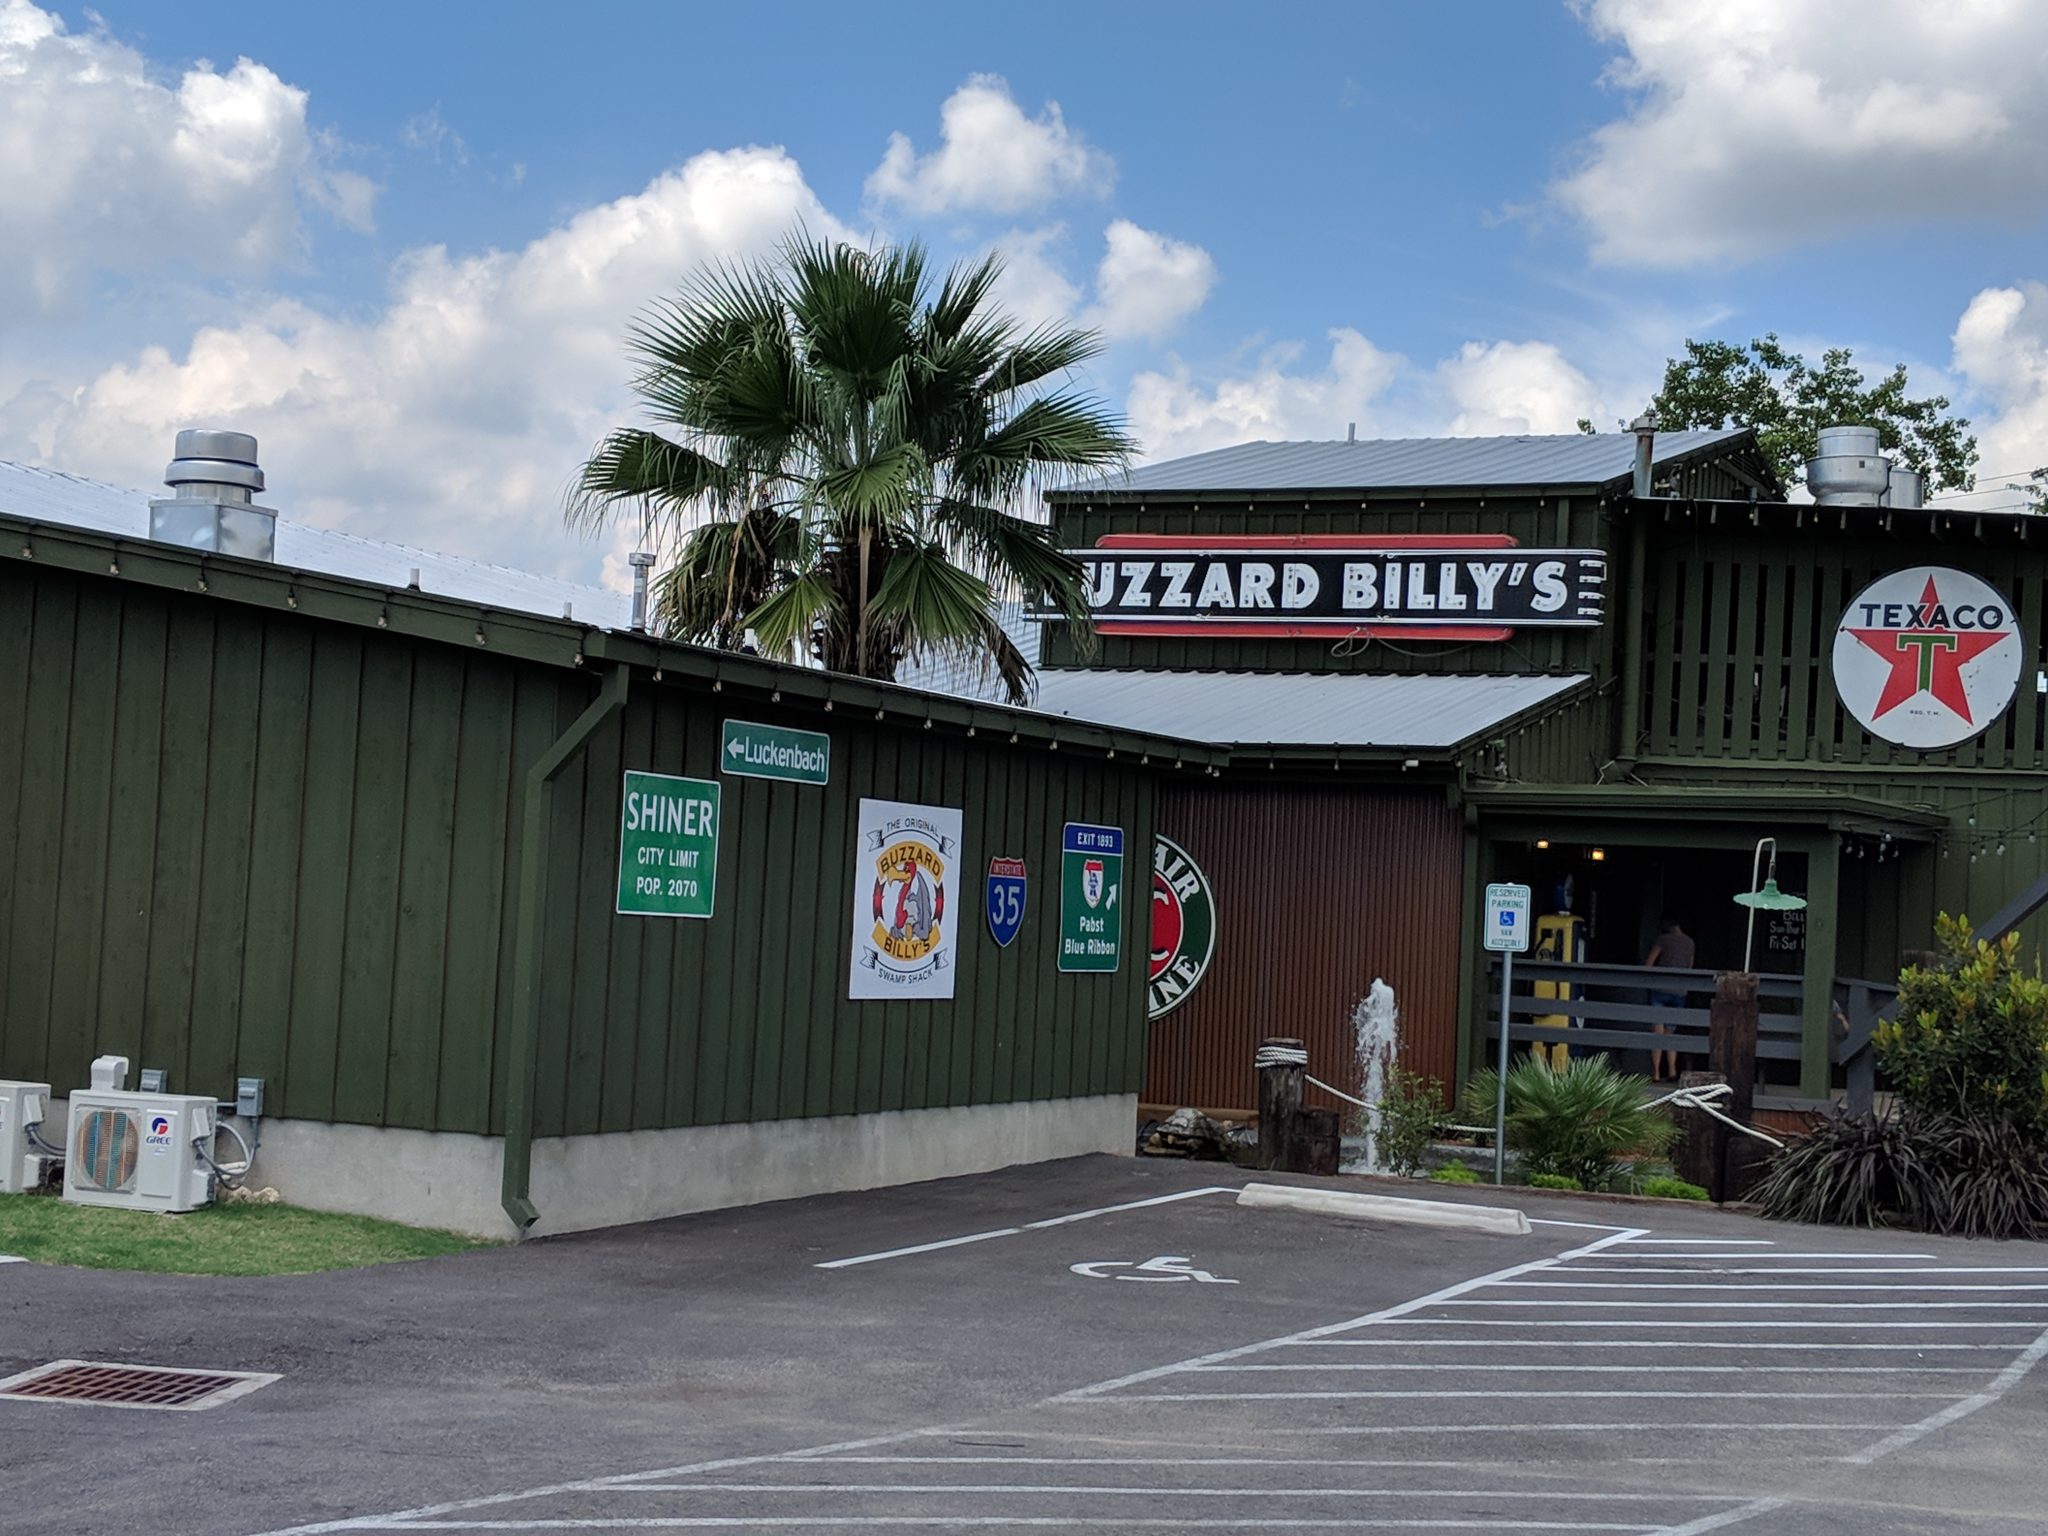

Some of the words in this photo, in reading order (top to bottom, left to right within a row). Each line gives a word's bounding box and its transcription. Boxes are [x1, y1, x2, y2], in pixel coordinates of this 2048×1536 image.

[1043, 561, 1320, 609] UZZARD
[1342, 562, 1568, 612] BILLY'S
[1859, 603, 2004, 630] TEXACO
[744, 736, 825, 773] Luckenbach
[626, 791, 713, 838] SHINER
[886, 818, 901, 833] THE
[904, 817, 940, 838] ORIGINAL
[1077, 832, 1095, 846] EXIT
[1097, 834, 1114, 848] 1893
[637, 847, 665, 866] CITY
[668, 849, 699, 869] LIMIT
[880, 846, 941, 876] BUZZARD
[1154, 842, 1200, 903] AIR
[636, 876, 663, 896] POP.
[667, 880, 698, 898] 2070
[992, 884, 1021, 926] 35
[1491, 899, 1524, 909] PARKING
[1079, 916, 1105, 933] Pabst
[883, 936, 931, 960] BILLY'S
[1064, 938, 1086, 955] Blue
[1087, 938, 1116, 956] Ribbon
[878, 968, 906, 984] SWAMP
[908, 967, 933, 985] SHACK
[1149, 955, 1200, 1012] INE
